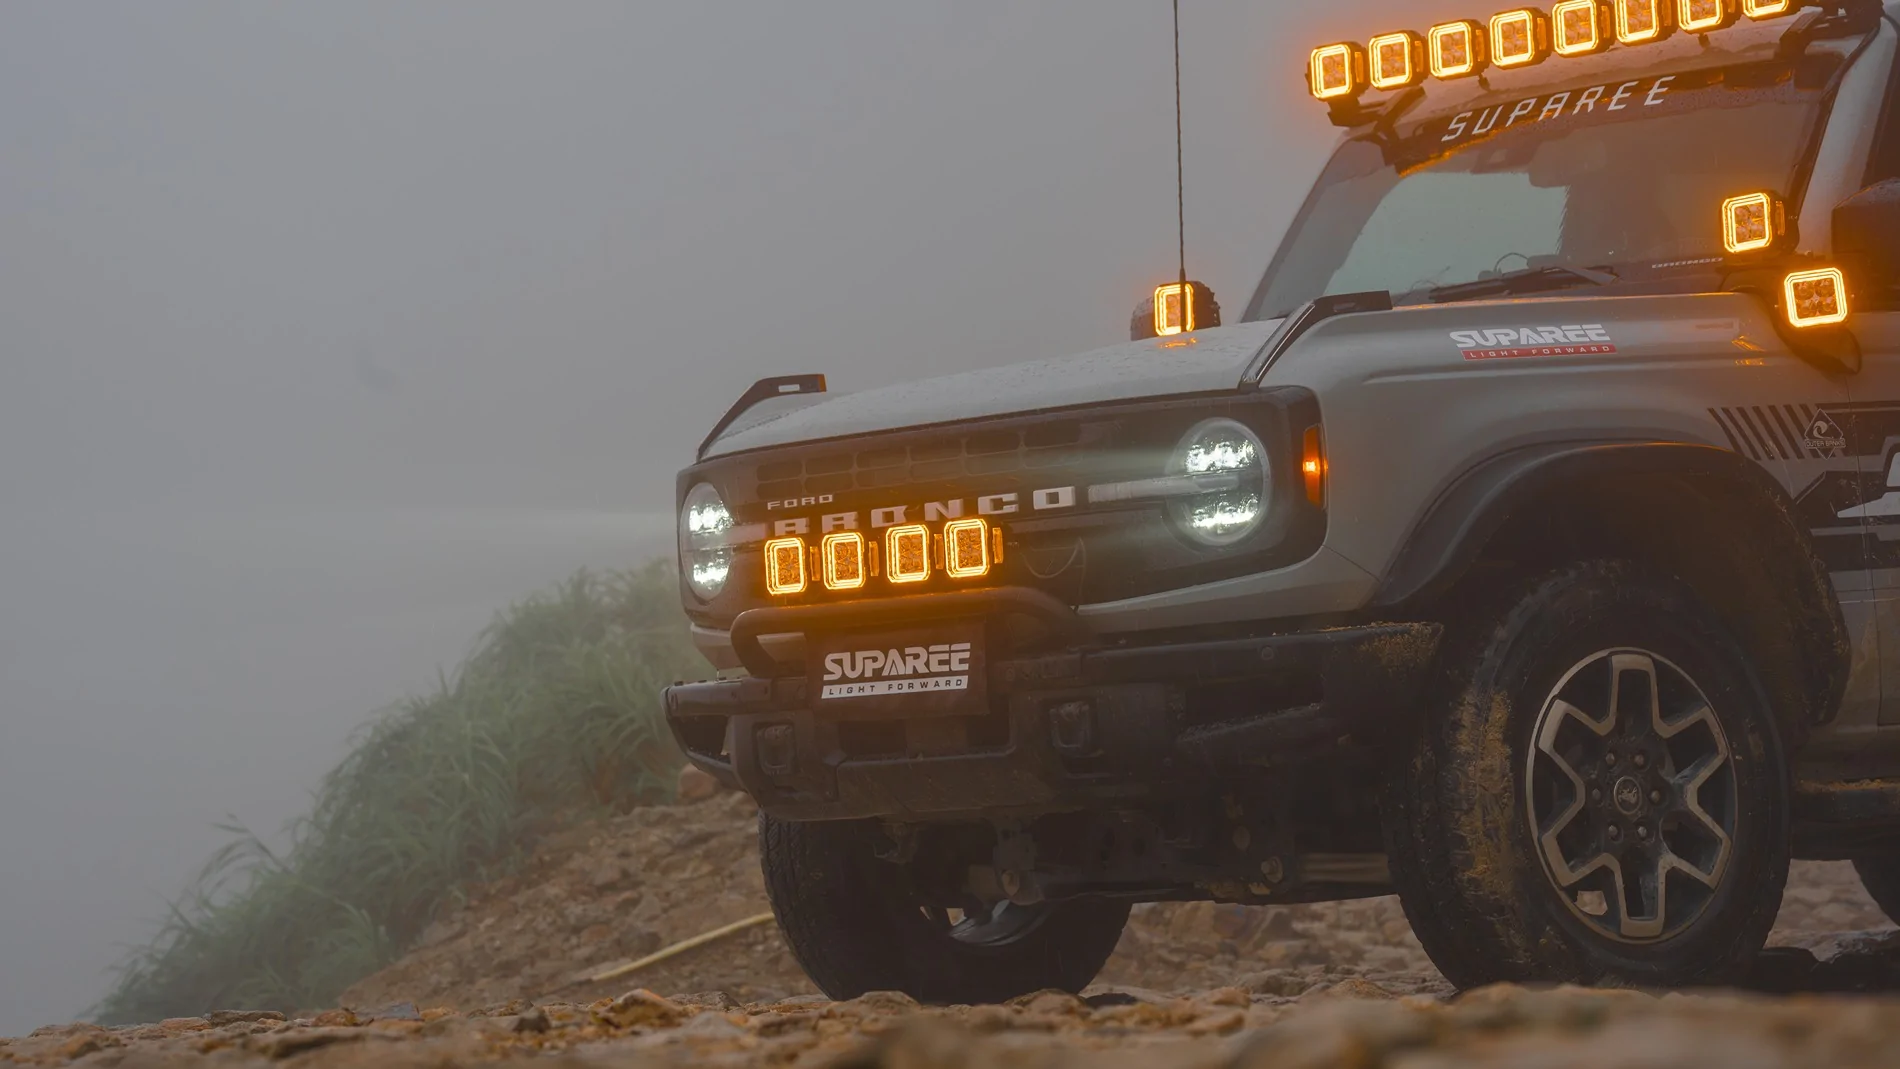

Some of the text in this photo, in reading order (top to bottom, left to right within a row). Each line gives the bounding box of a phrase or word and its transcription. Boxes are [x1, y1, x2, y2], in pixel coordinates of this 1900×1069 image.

[1441, 75, 1676, 141] SUPAREE
[1449, 323, 1611, 348] SUPAREE
[1470, 345, 1610, 358] LIGHT FORWARD
[767, 494, 833, 510] FORD
[823, 642, 971, 681] SUPAREE
[829, 679, 962, 695] LIGHT FORWARD
